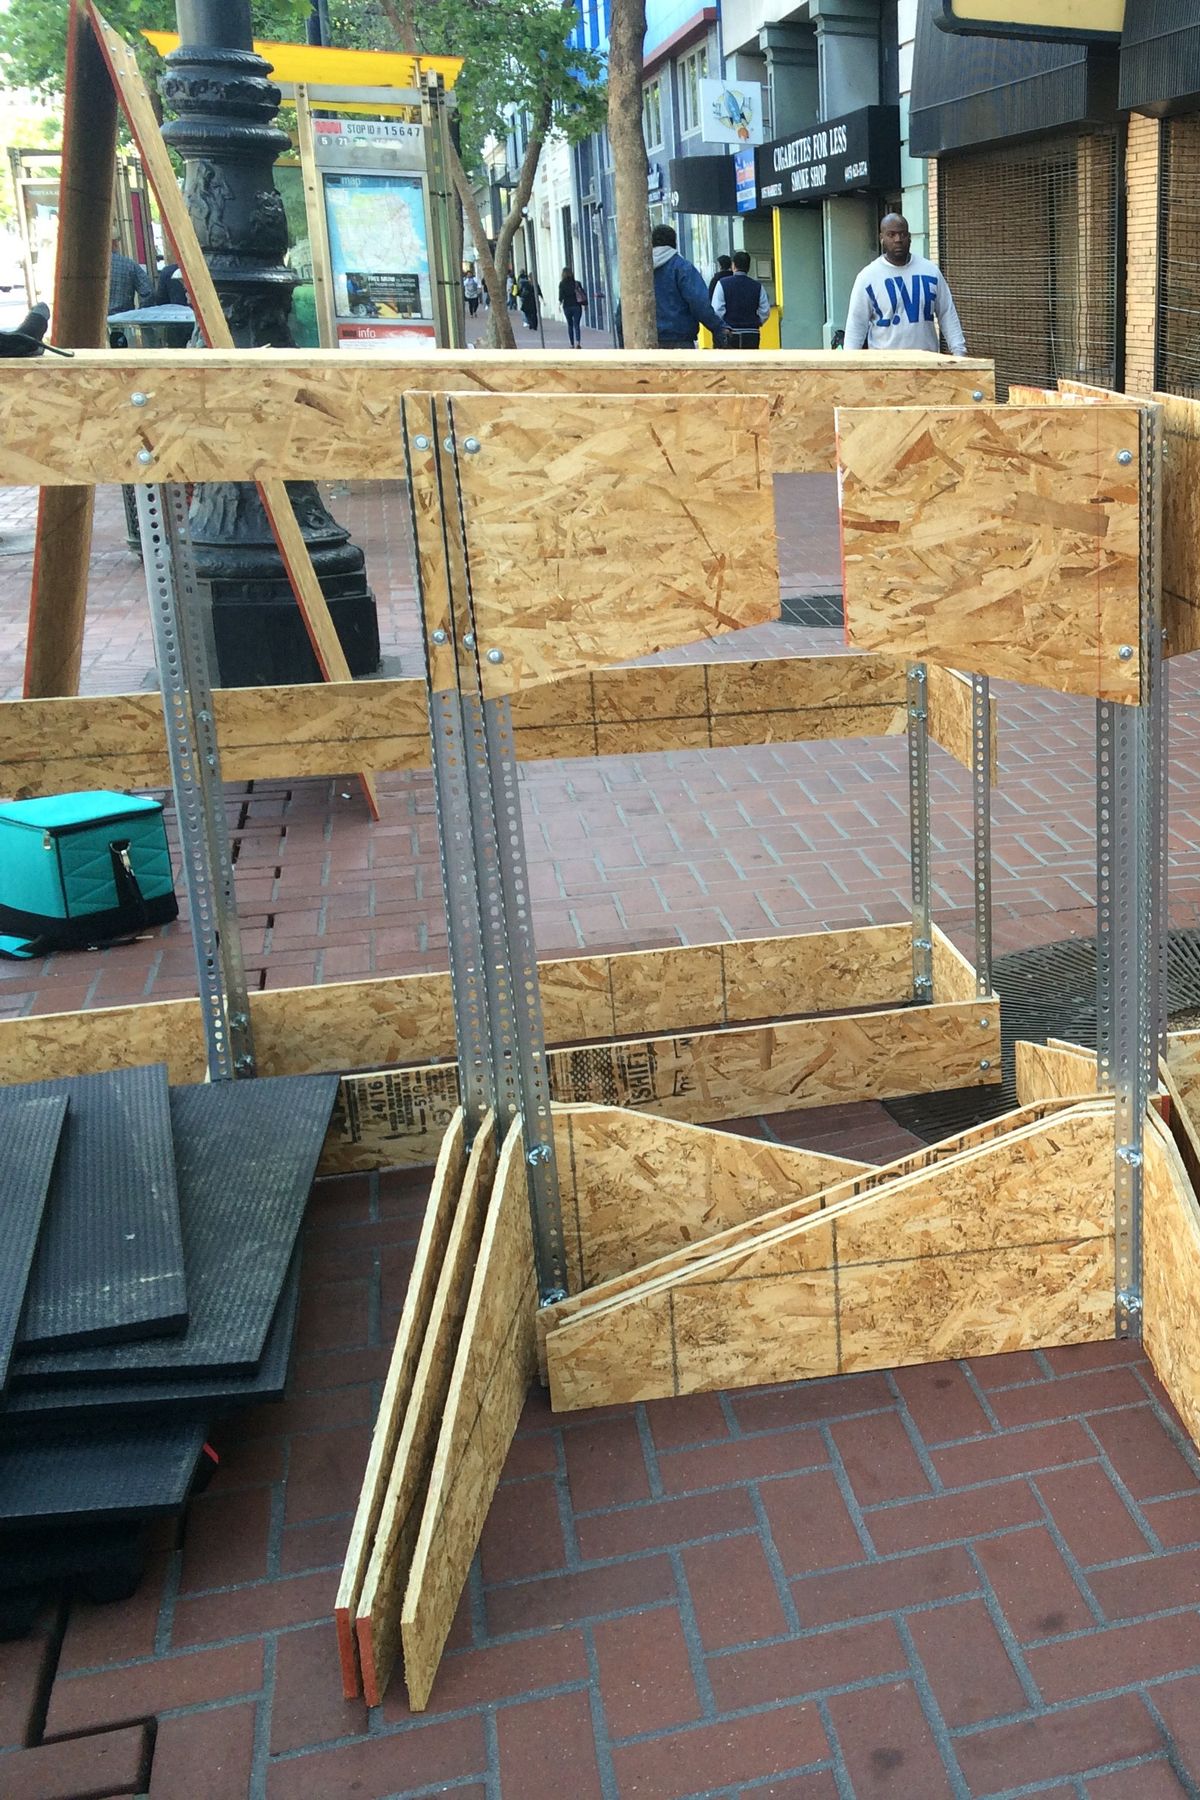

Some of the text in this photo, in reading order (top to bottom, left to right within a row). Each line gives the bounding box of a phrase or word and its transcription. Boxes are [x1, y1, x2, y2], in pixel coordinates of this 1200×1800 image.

[347, 124, 365, 134] STOP
[367, 126, 375, 135] ID
[384, 126, 420, 137] 15647
[773, 136, 811, 172] CIGARETTES
[813, 131, 828, 160] FOR
[829, 124, 847, 156] LESS
[341, 176, 361, 188] map
[791, 167, 810, 192] SMOKE
[810, 163, 827, 187] SHOP
[358, 328, 376, 338] info
